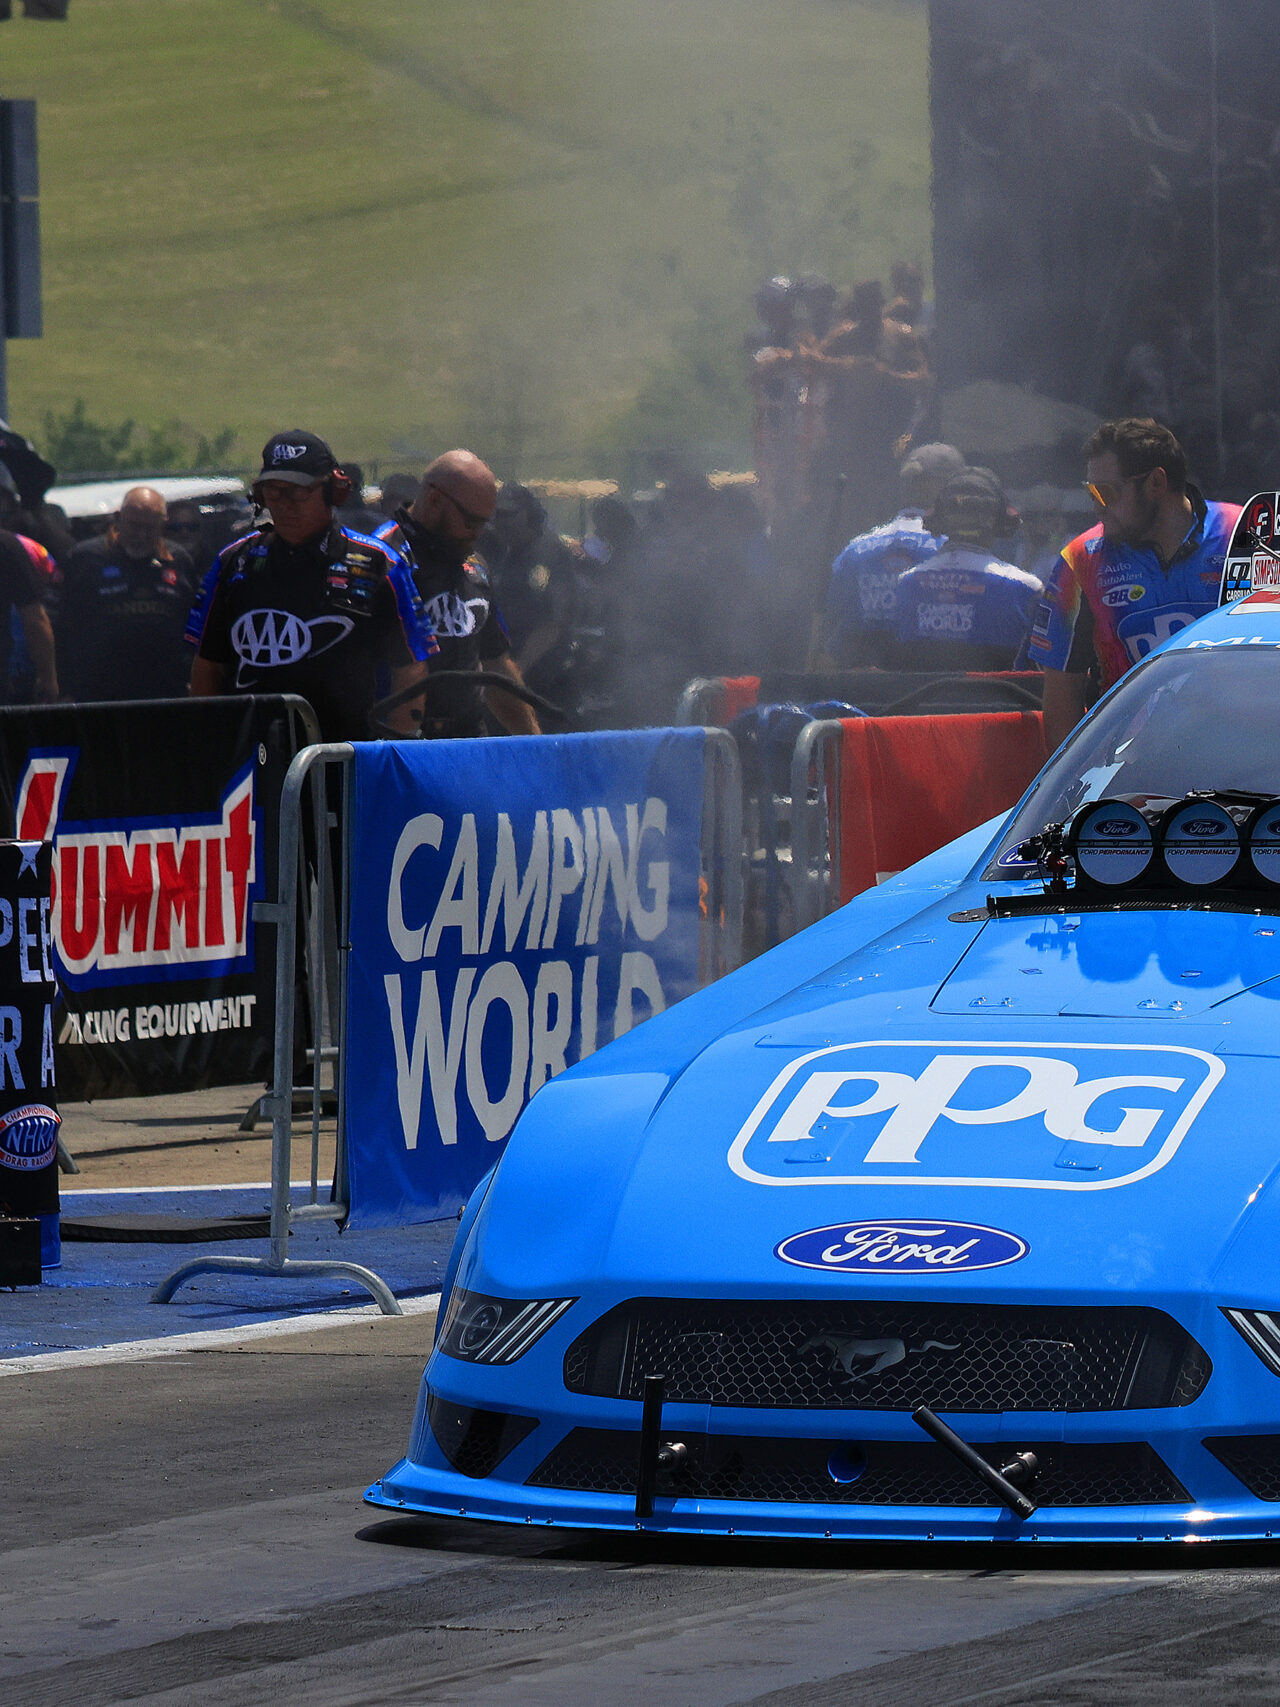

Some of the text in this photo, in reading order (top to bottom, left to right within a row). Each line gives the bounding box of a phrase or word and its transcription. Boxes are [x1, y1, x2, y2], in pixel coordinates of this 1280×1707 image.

[233, 609, 310, 666] AAA
[1103, 821, 1131, 834] Ford
[1189, 821, 1218, 834] Ford
[1098, 848, 1150, 856] PERFORMANCE
[1185, 848, 1237, 856] PERFORMANCE
[387, 797, 670, 962] CAMPING
[135, 994, 257, 1040] EQUIPMENT
[767, 1054, 1187, 1163] PPG
[6, 1117, 56, 1153] NHRA
[5, 1154, 29, 1167] DRAG
[820, 1226, 981, 1266] Ford
